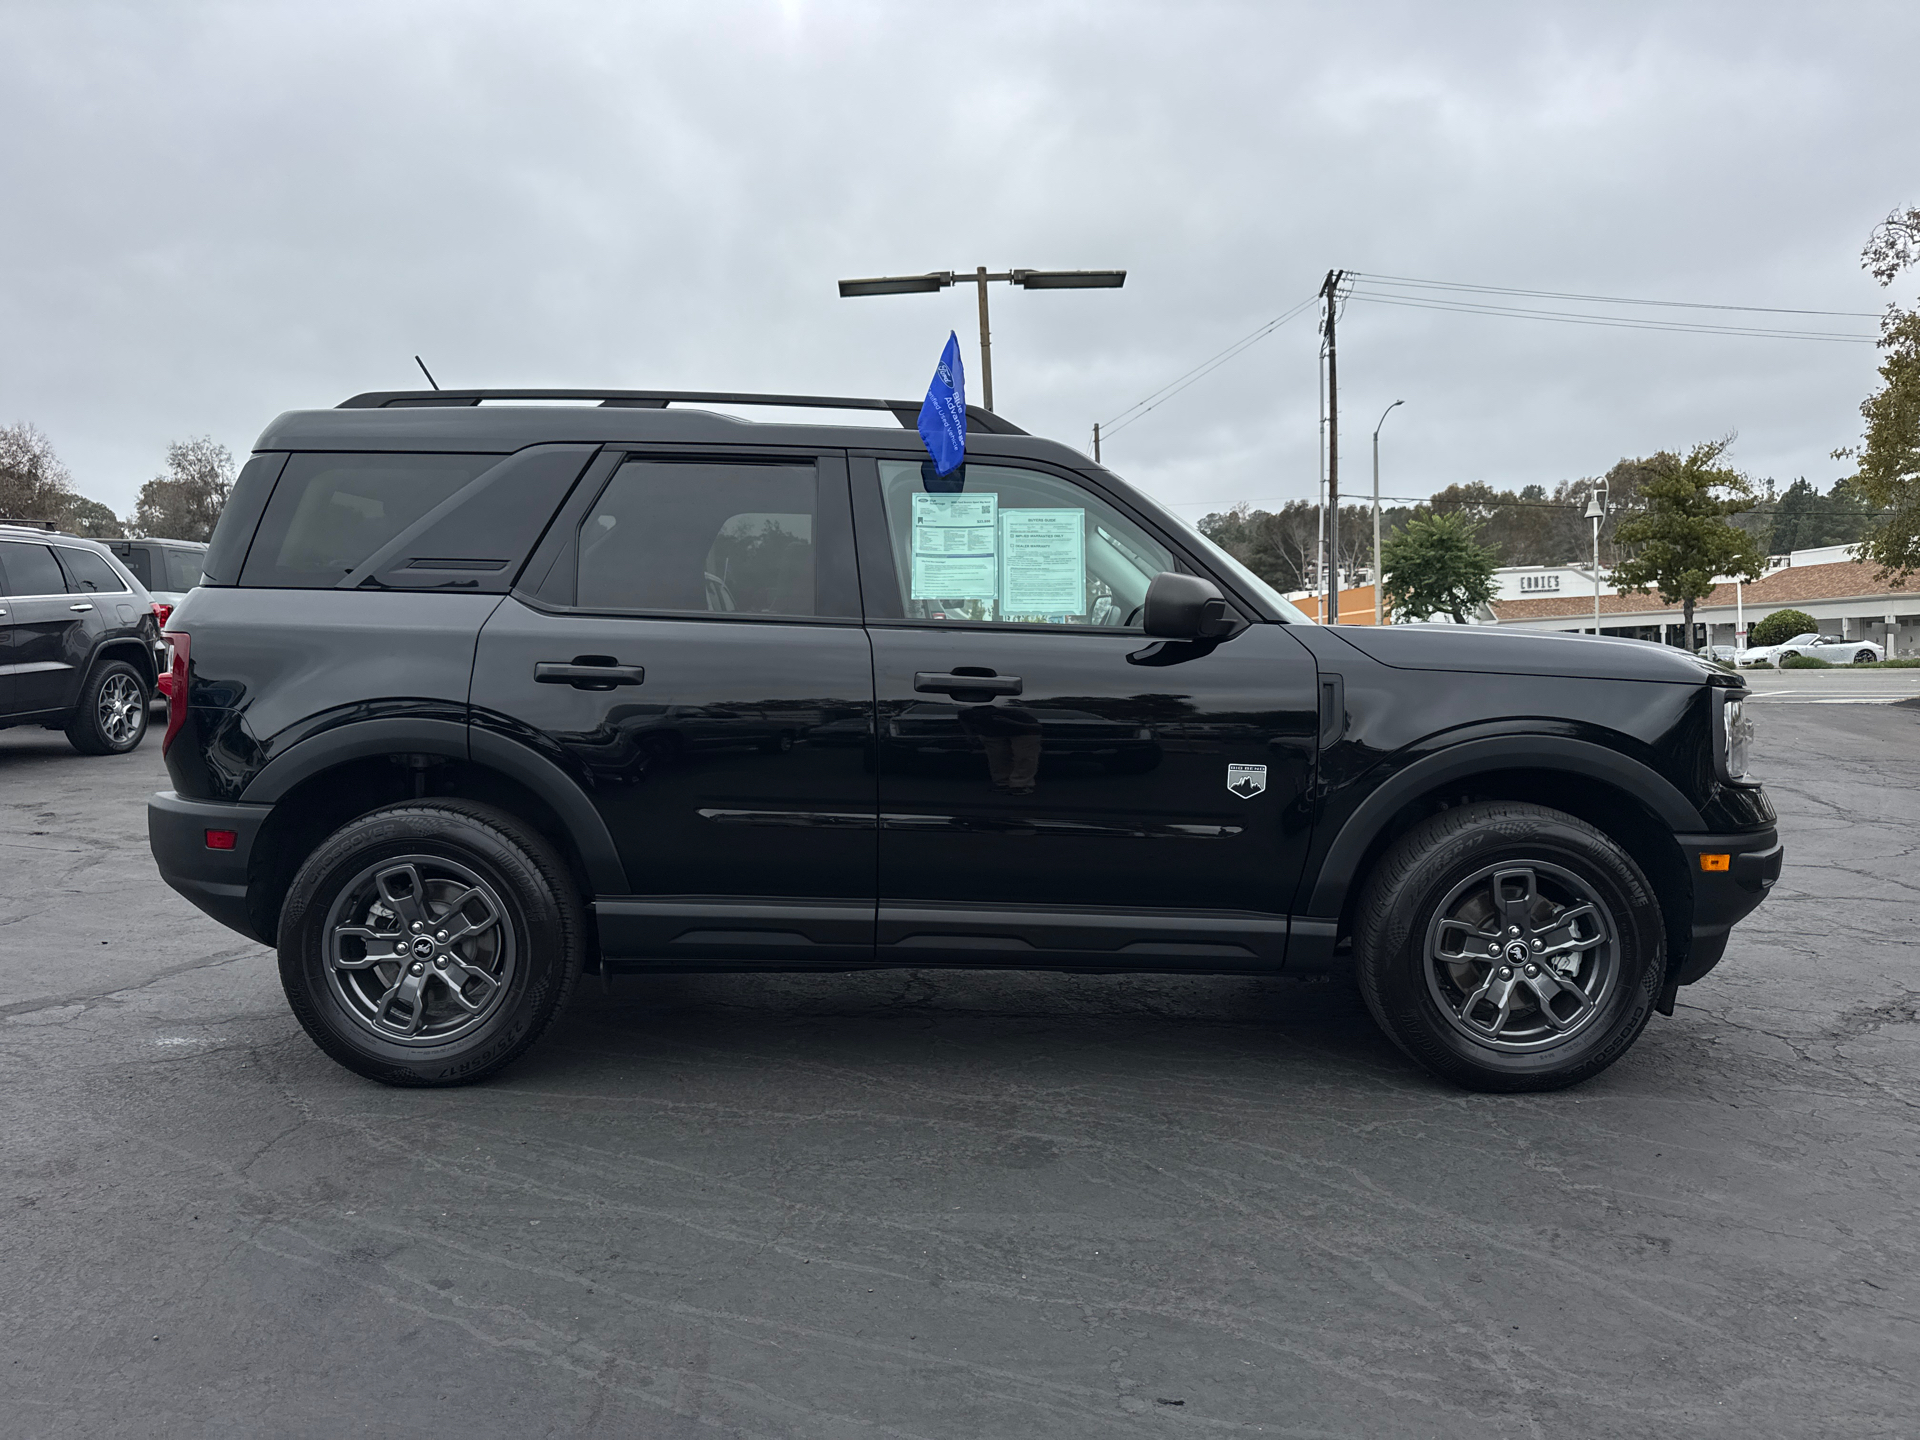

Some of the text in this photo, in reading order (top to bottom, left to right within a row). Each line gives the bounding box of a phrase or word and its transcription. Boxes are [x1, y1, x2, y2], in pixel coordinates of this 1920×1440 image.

[938, 364, 952, 384] Ford
[928, 388, 959, 451] ertified Used Vehicle
[944, 396, 965, 446] Advantage
[952, 391, 963, 414] Blue
[309, 824, 395, 884] CROSSOVER
[1603, 852, 1649, 906] MOHAVE
[438, 1020, 523, 1078] 225/65R17
